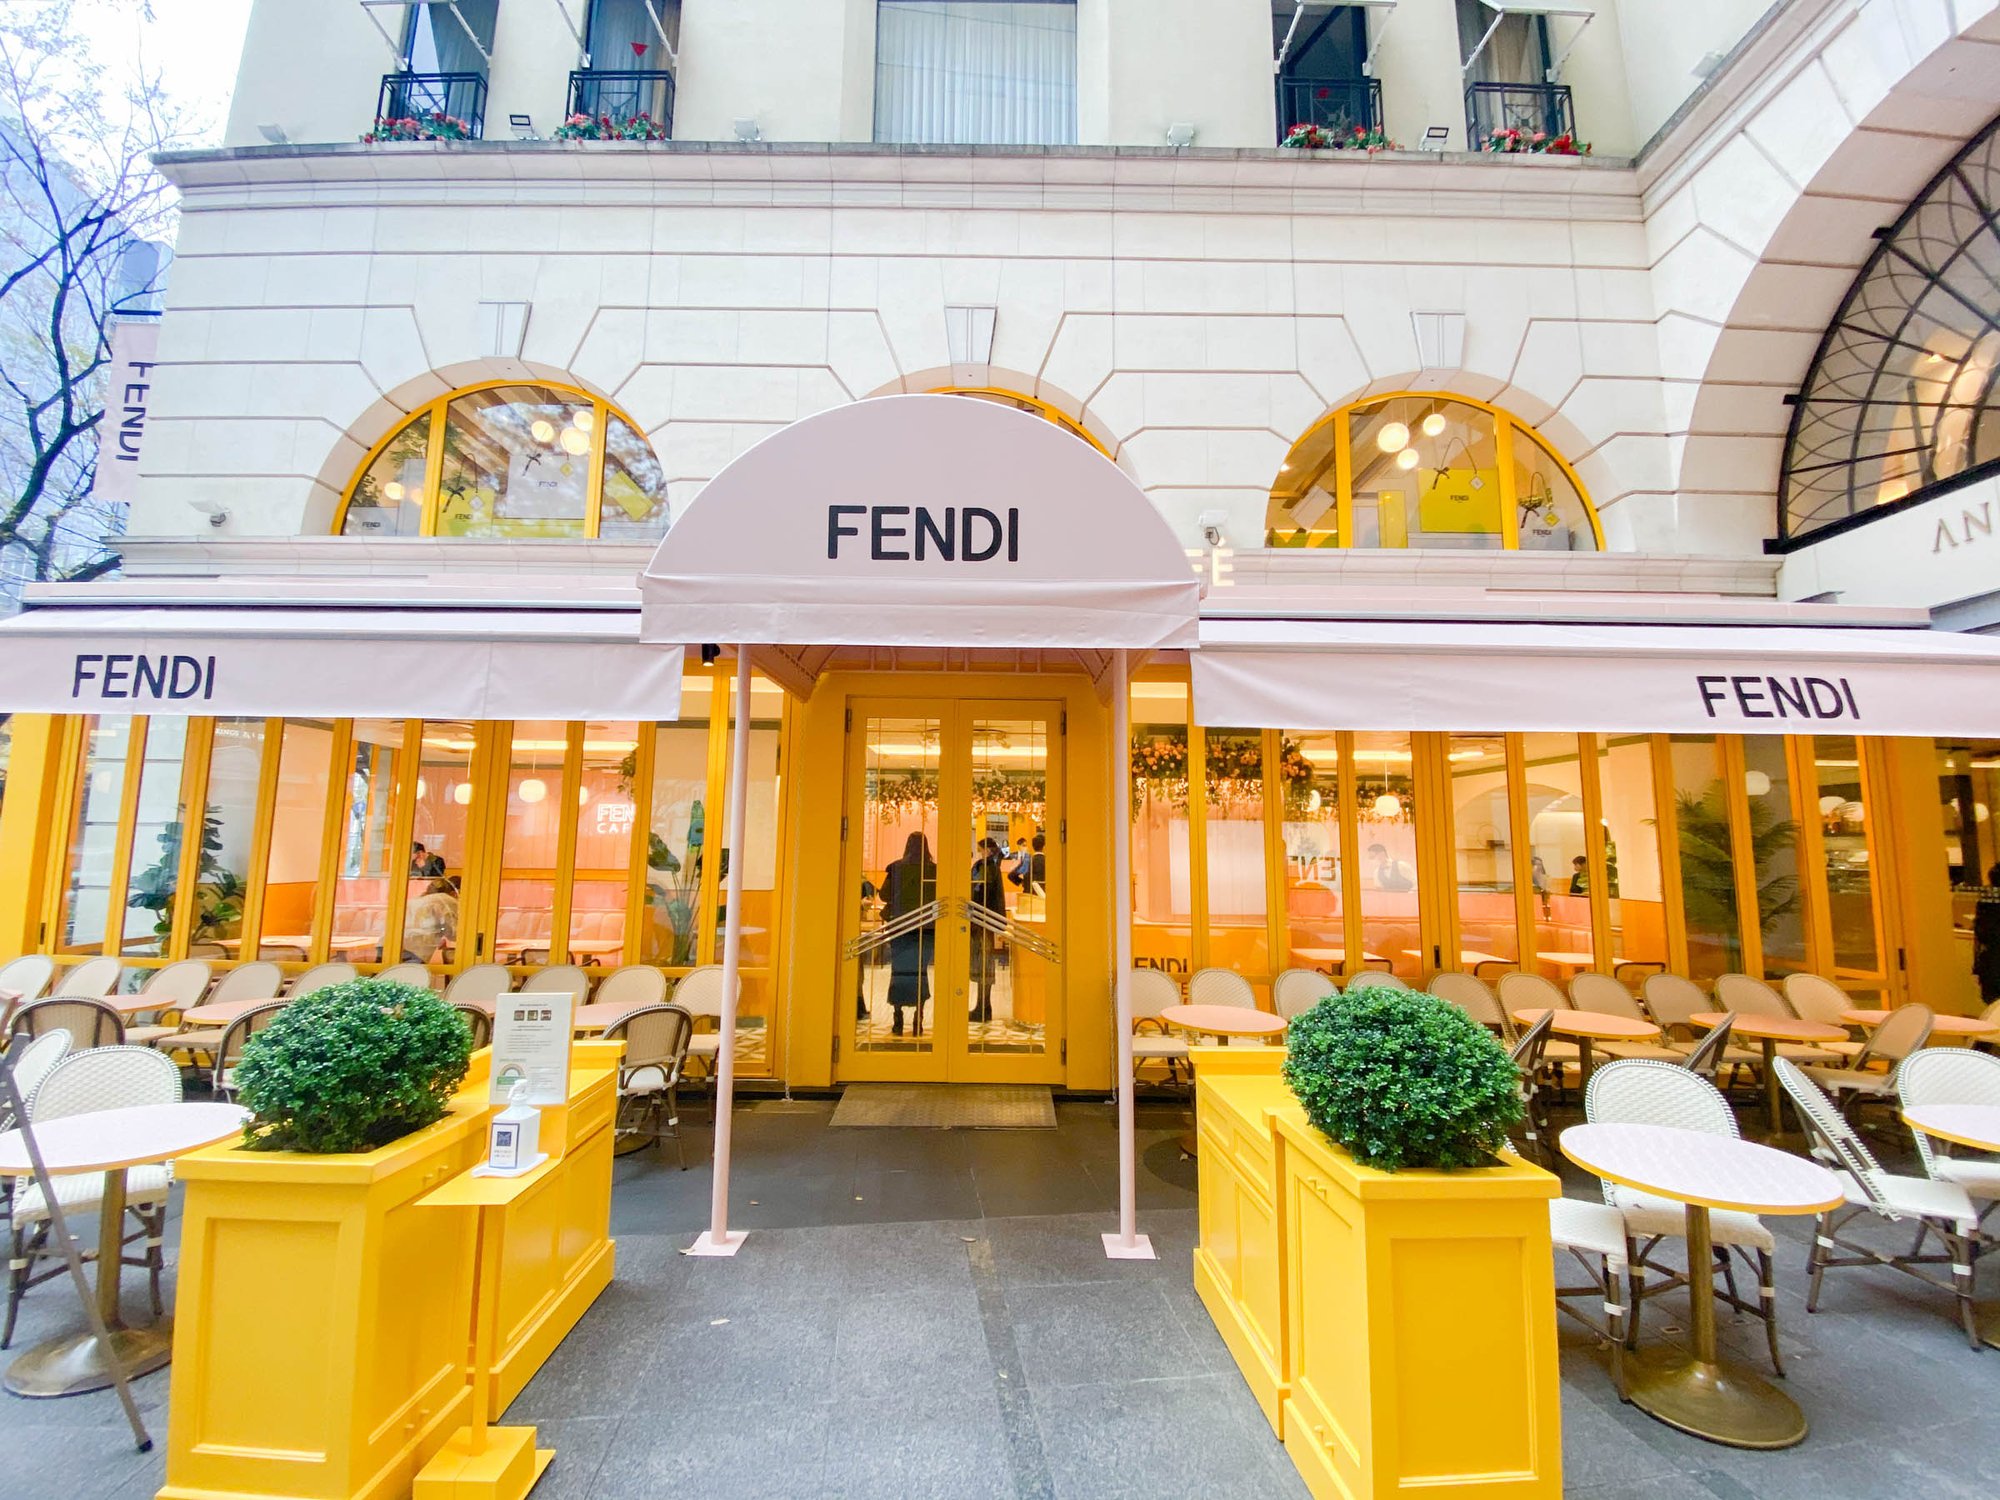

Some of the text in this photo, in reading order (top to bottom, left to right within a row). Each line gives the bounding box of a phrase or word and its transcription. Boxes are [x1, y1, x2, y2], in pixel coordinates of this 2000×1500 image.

[116, 362, 154, 462] FENDI
[827, 504, 1019, 562] FENDI
[72, 654, 216, 701] FENDI
[1697, 675, 1862, 720] FENDI
[1134, 957, 1188, 974] ENDI
